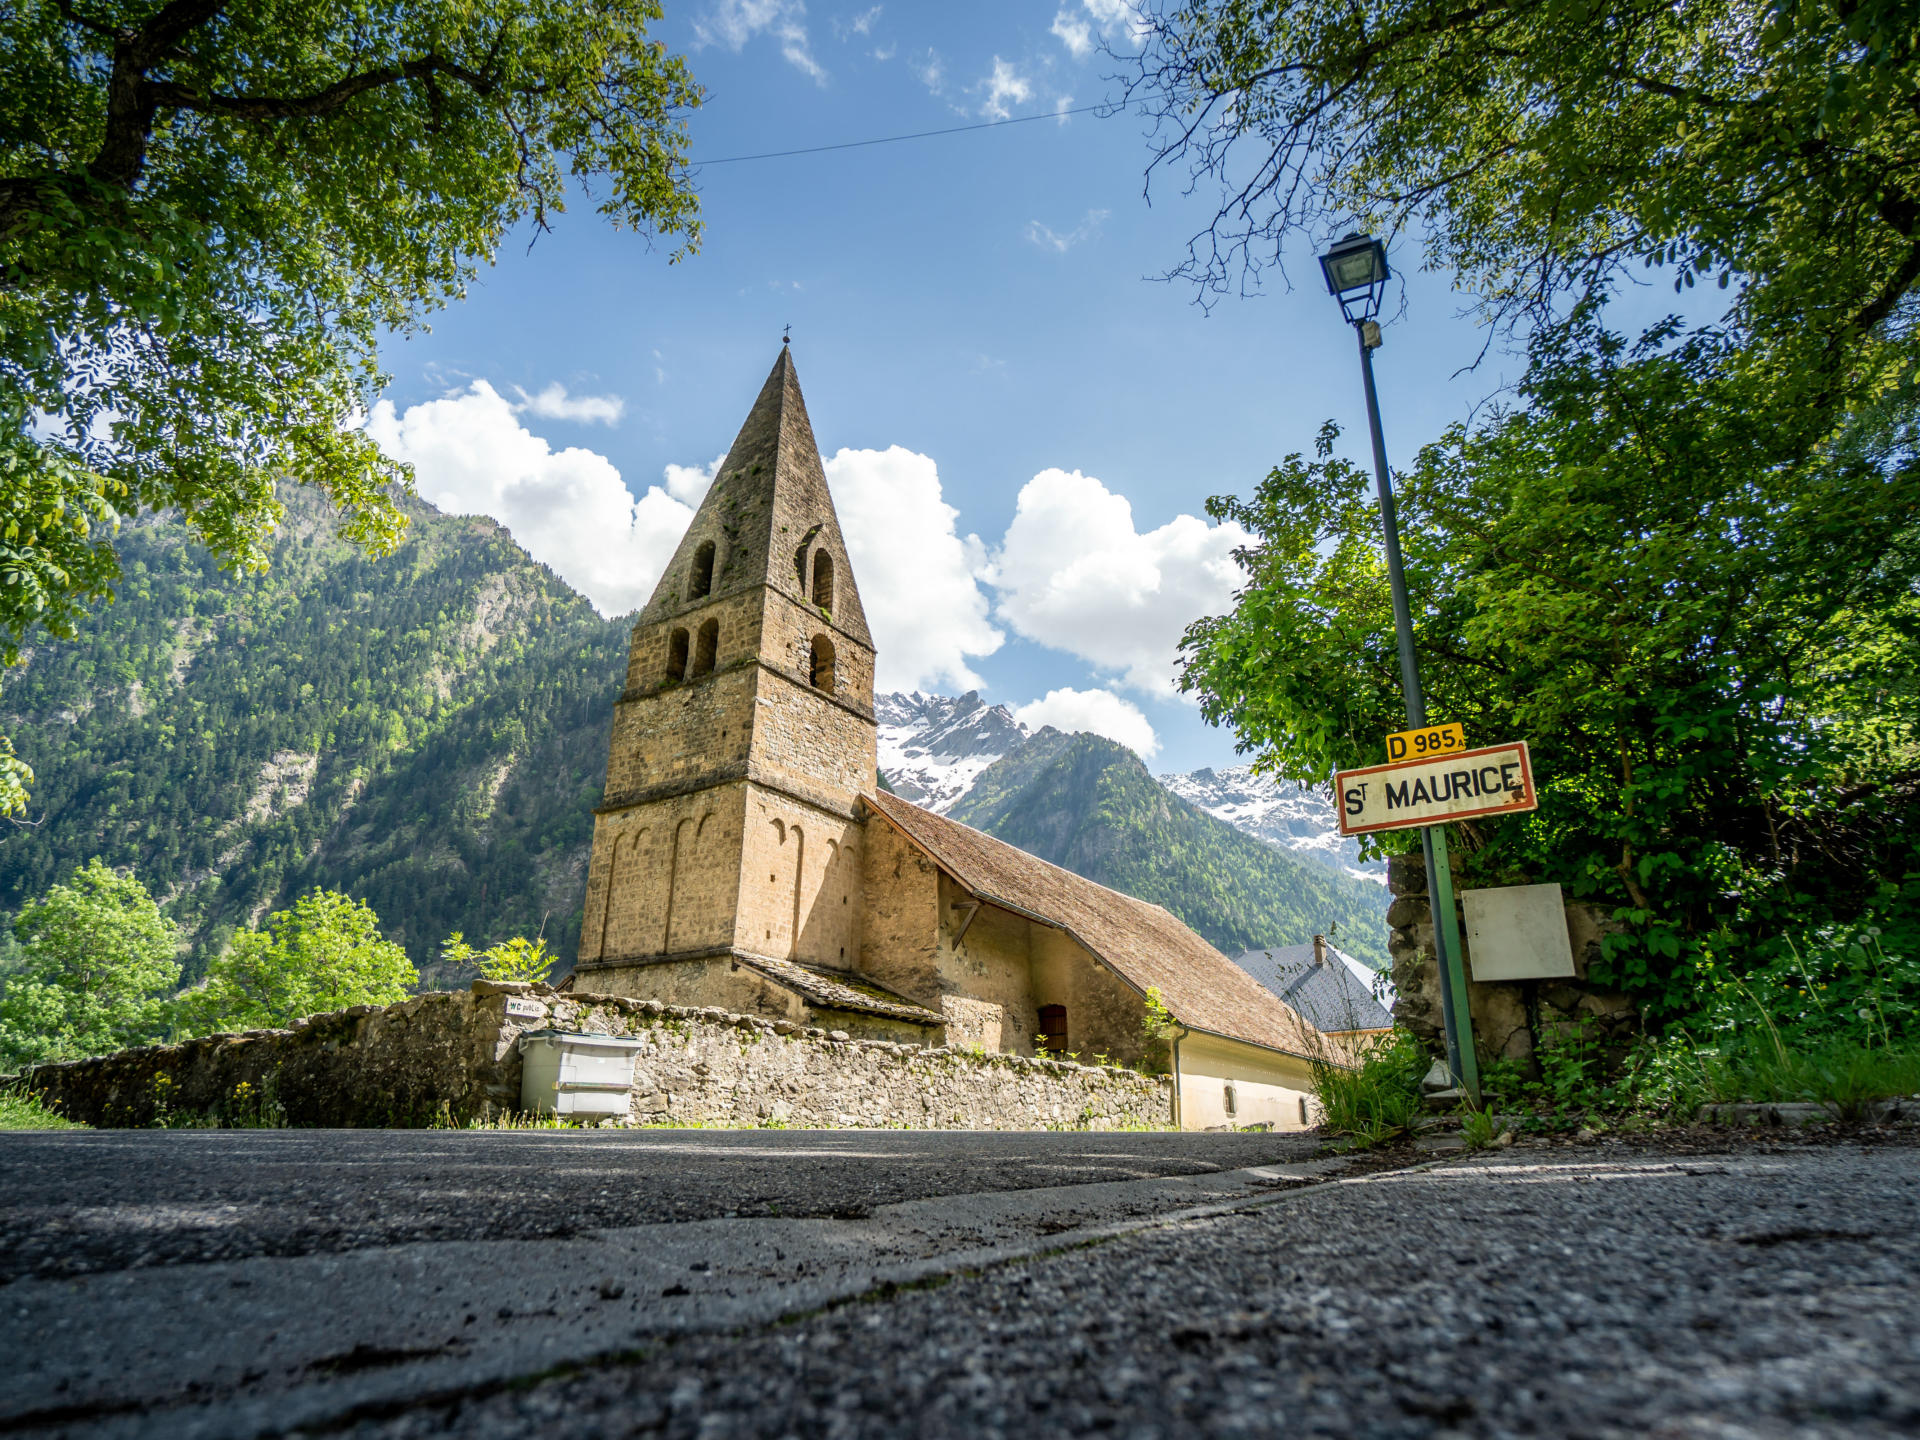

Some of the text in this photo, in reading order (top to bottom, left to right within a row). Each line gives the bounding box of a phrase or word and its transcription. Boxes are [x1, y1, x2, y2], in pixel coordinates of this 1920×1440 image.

[1389, 736, 1406, 759] D
[1344, 762, 1523, 815] ST MAURICE
[510, 1002, 521, 1011] WC
